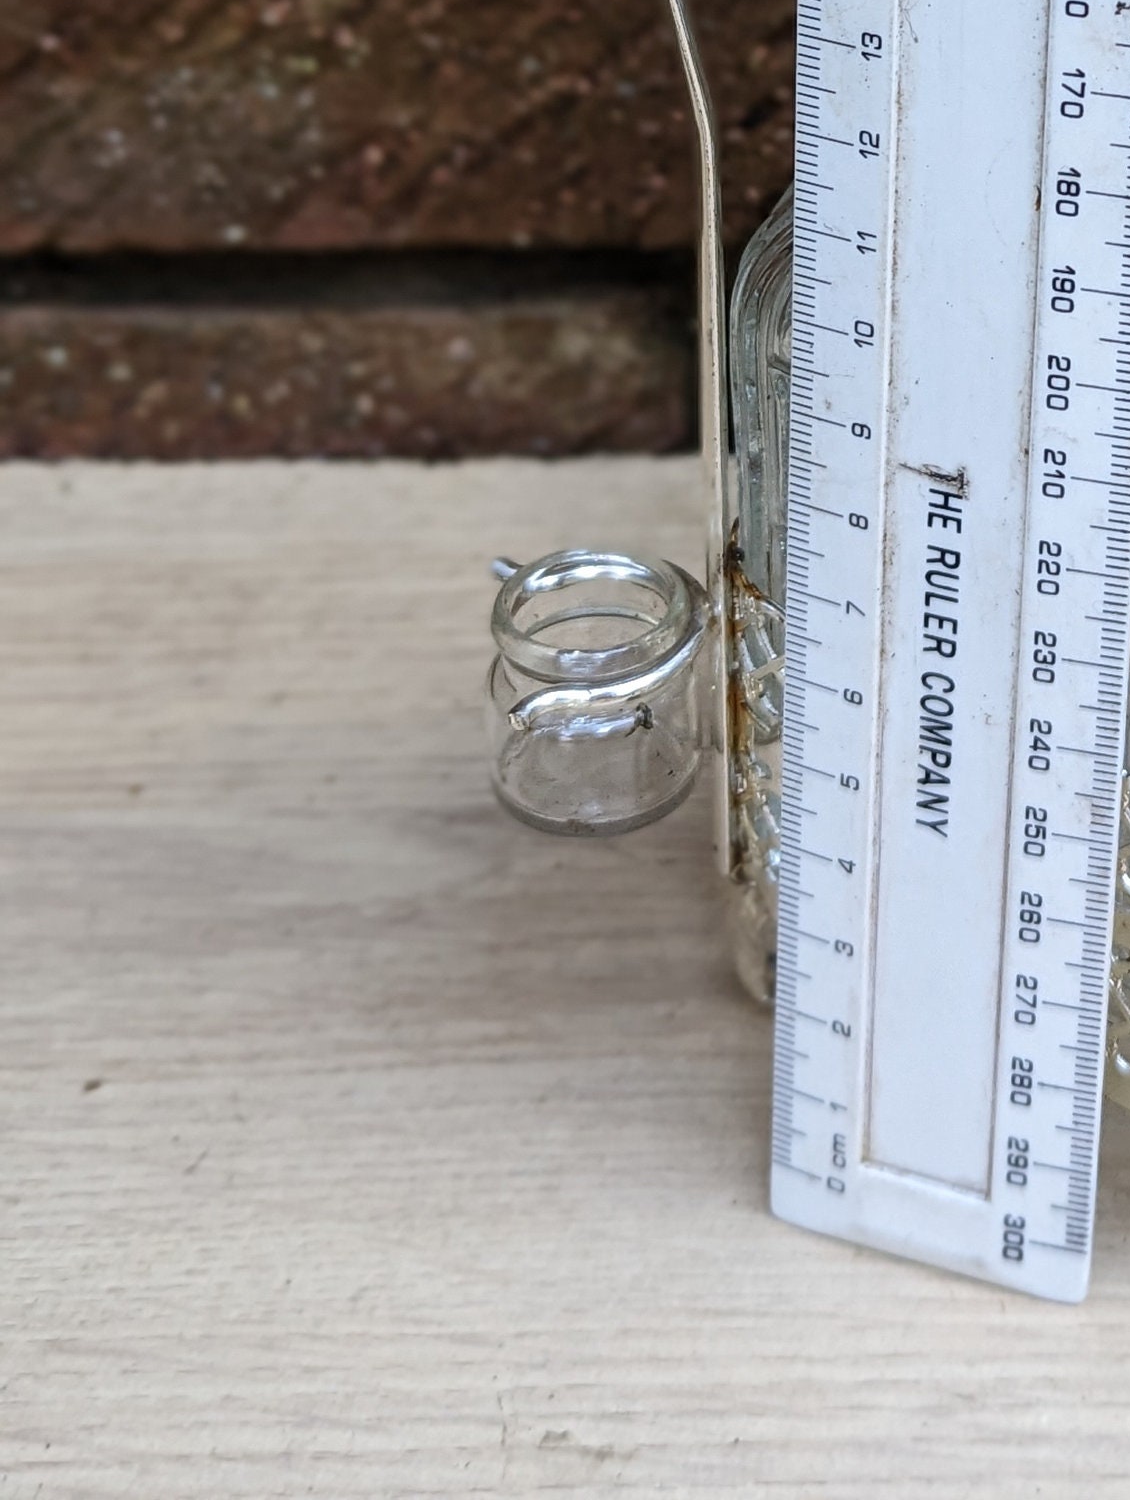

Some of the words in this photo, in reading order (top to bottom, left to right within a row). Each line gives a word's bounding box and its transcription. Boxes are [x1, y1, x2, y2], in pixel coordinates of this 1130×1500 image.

[860, 31, 883, 62] 13
[1059, 67, 1087, 120] 170
[858, 129, 881, 160] 12
[1054, 166, 1082, 218] 180
[855, 230, 878, 255] 11
[1050, 264, 1077, 314] 190
[853, 319, 875, 349] 10
[1045, 354, 1072, 412] 200
[850, 422, 872, 441] 9
[1041, 447, 1067, 500] 210
[848, 512, 869, 531] 8
[927, 466, 966, 534] THE
[1036, 539, 1063, 596] 220
[845, 600, 866, 617] 7
[921, 544, 962, 660] RULER
[1031, 630, 1058, 685] 230
[842, 687, 864, 707] 6
[915, 671, 956, 839] COMPANY
[1027, 717, 1053, 773] 240
[839, 772, 860, 792] 5
[1022, 805, 1048, 859] 250
[837, 857, 857, 875] 4
[1018, 890, 1043, 944] 260
[833, 939, 854, 958] 3
[1013, 973, 1039, 1027] 270
[831, 1020, 852, 1040] 2
[829, 1101, 847, 1112] 1
[1009, 1056, 1034, 1109] 280
[831, 1133, 847, 1170] cm
[1005, 1136, 1030, 1189] 290
[827, 1175, 846, 1194] 0
[1001, 1213, 1026, 1264] 300
